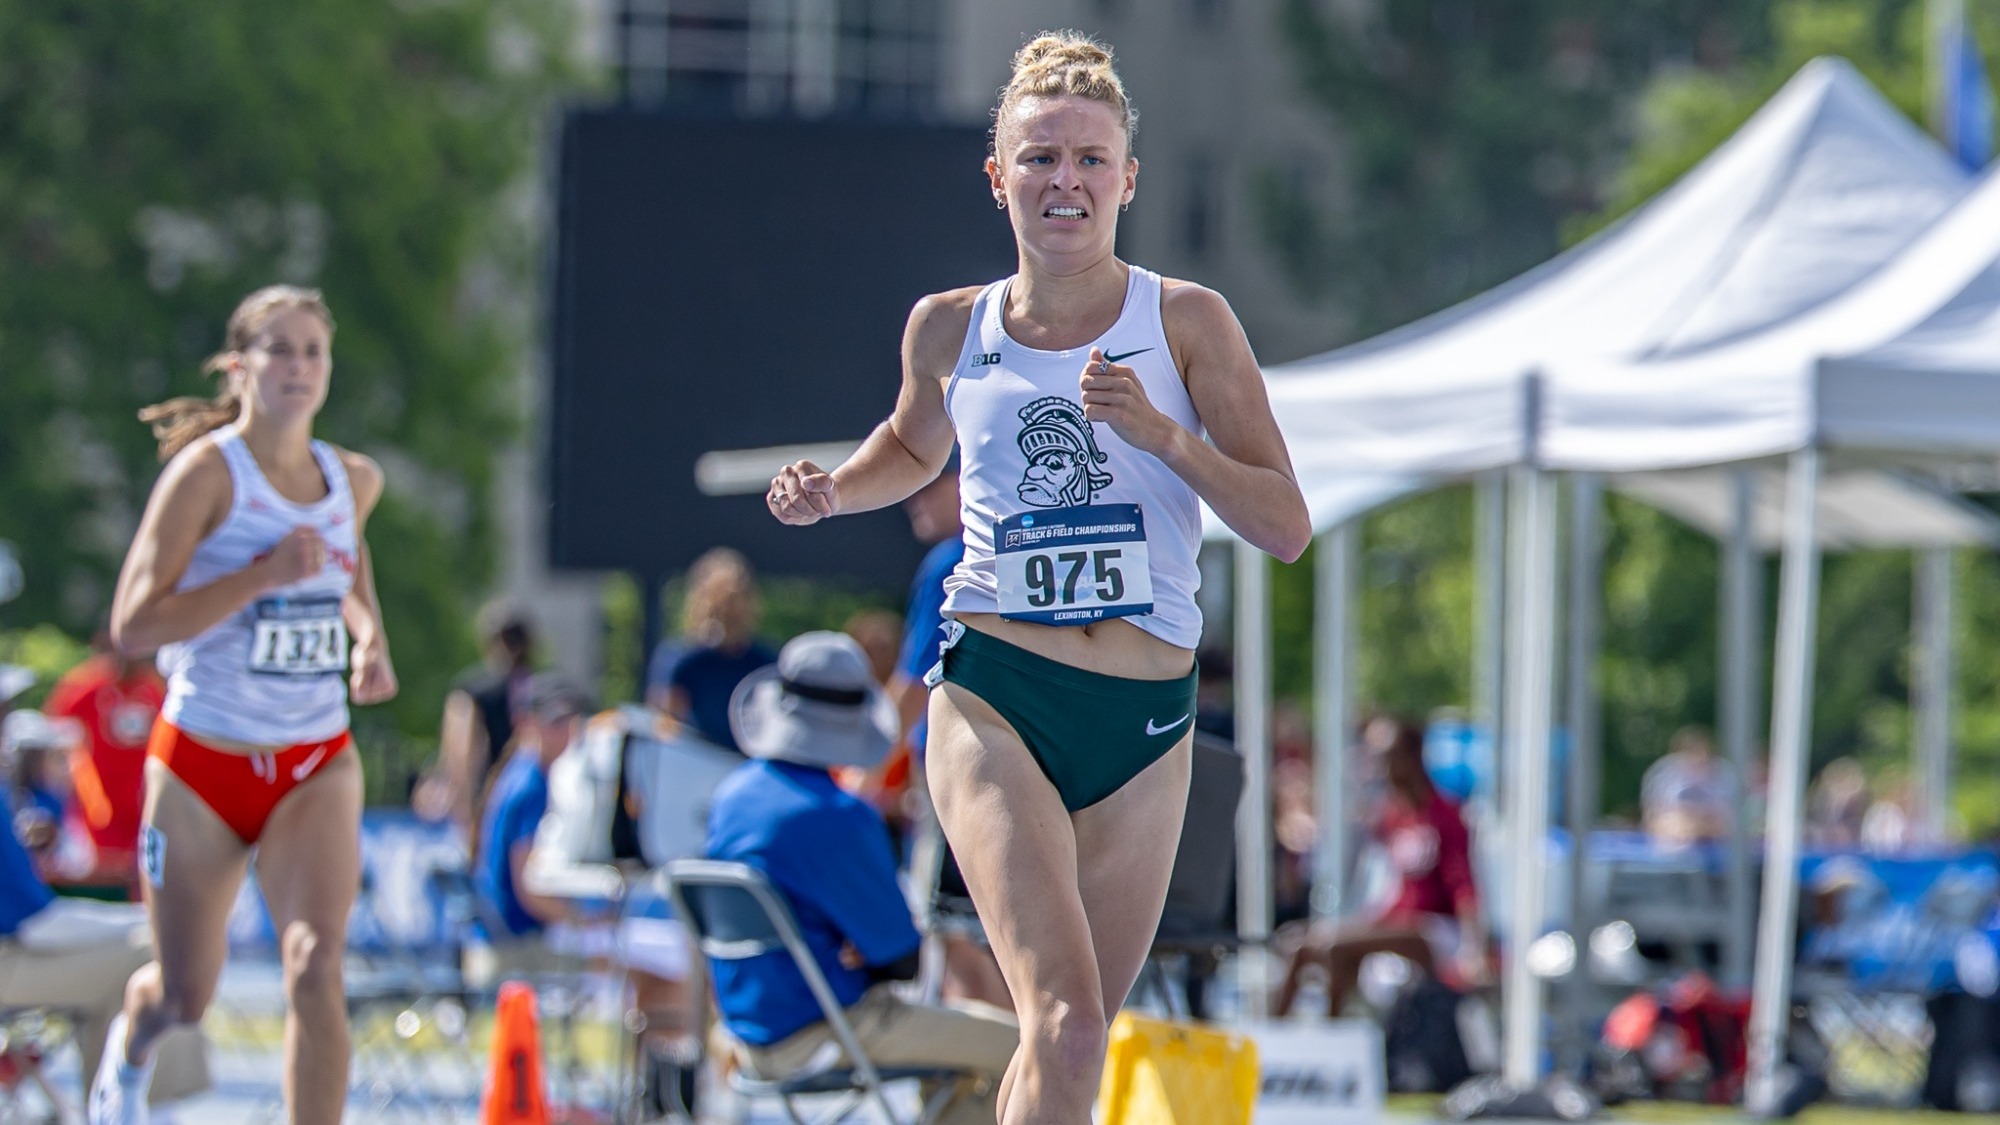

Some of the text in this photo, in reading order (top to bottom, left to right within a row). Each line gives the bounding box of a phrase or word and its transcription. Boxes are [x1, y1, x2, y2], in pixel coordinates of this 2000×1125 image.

[1022, 530, 1046, 541] TRACK
[1046, 528, 1053, 538] &
[1053, 527, 1074, 538] FIELD
[1074, 523, 1136, 536] CHAMPIONSHIPS
[1025, 549, 1125, 607] 975
[1054, 609, 1104, 620] LEXINGTON, KY
